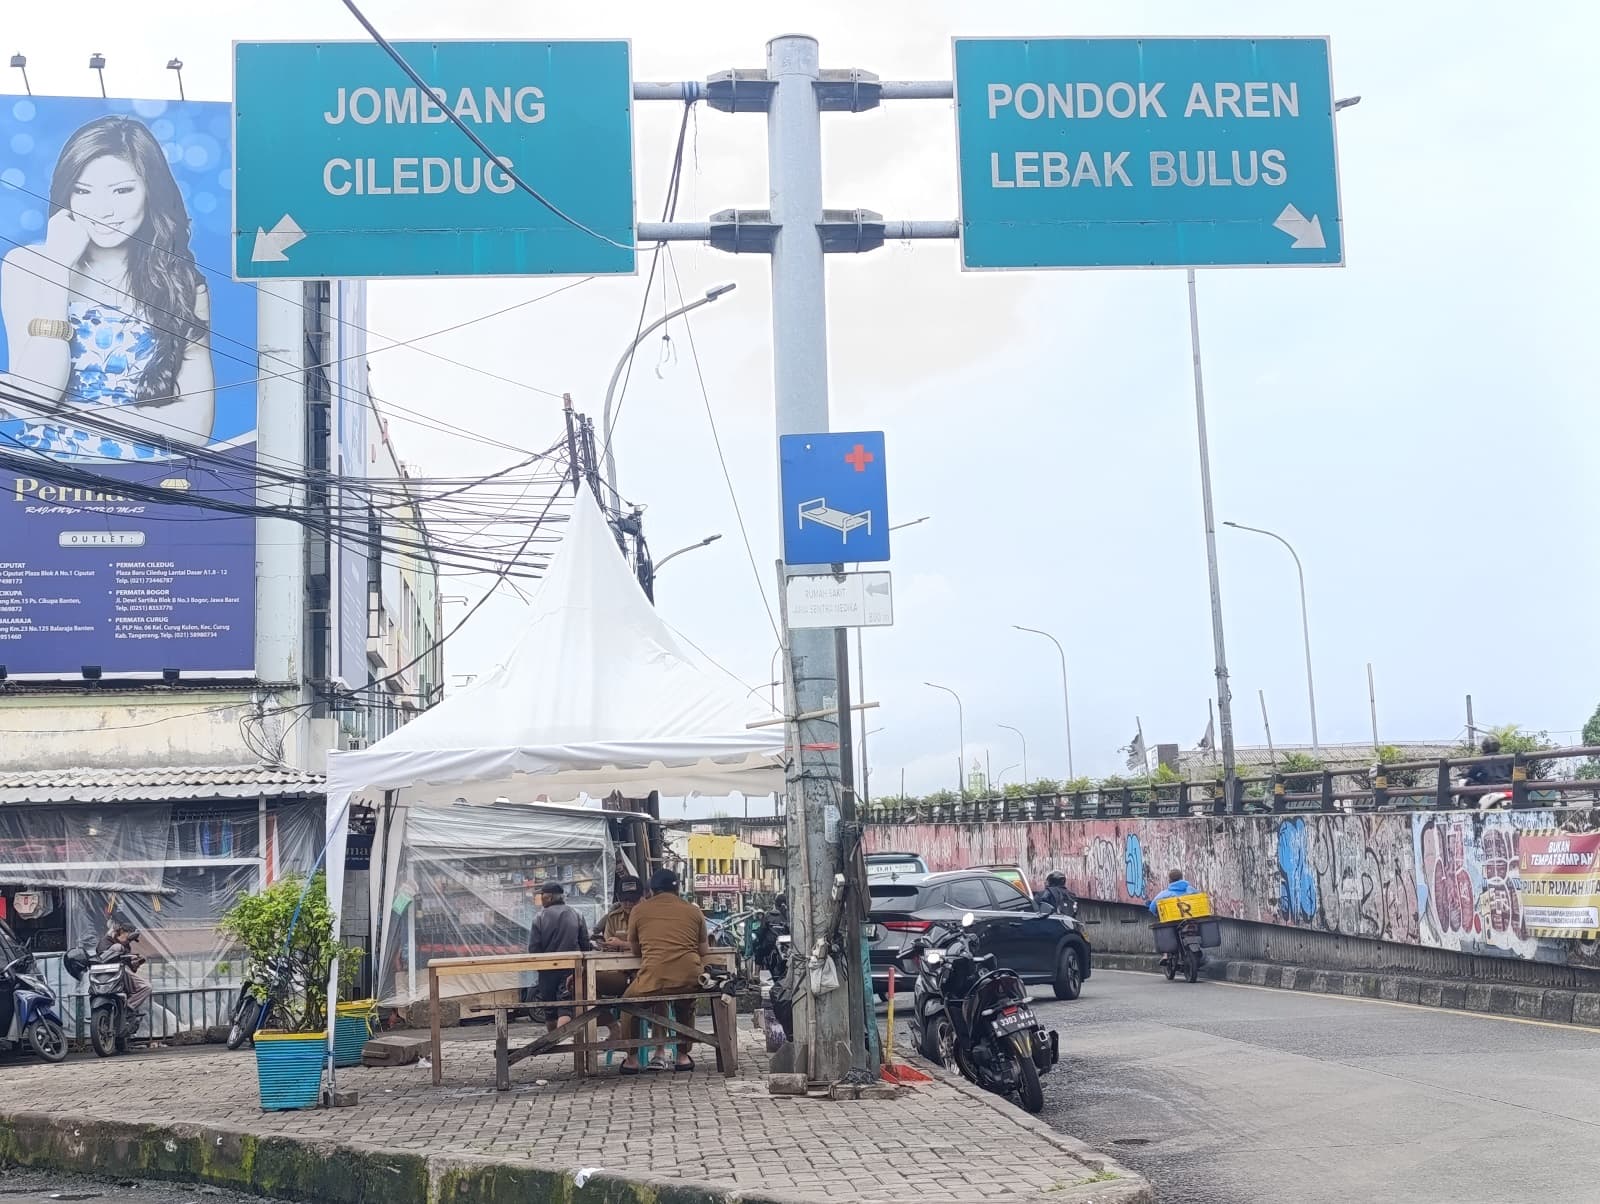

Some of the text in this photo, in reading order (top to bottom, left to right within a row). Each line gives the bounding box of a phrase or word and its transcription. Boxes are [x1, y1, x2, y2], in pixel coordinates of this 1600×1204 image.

[323, 86, 546, 125] JOMBANG
[987, 81, 1299, 119] PONDOK AREN
[322, 156, 516, 196] CILEDUG
[990, 149, 1287, 189] LEBAK BULUS
[13, 478, 146, 501] Perma
[116, 506, 145, 514] MAS
[1548, 840, 1571, 853] BUKAN
[709, 875, 739, 885] SOLITE
[1548, 880, 1584, 896] RUMAH
